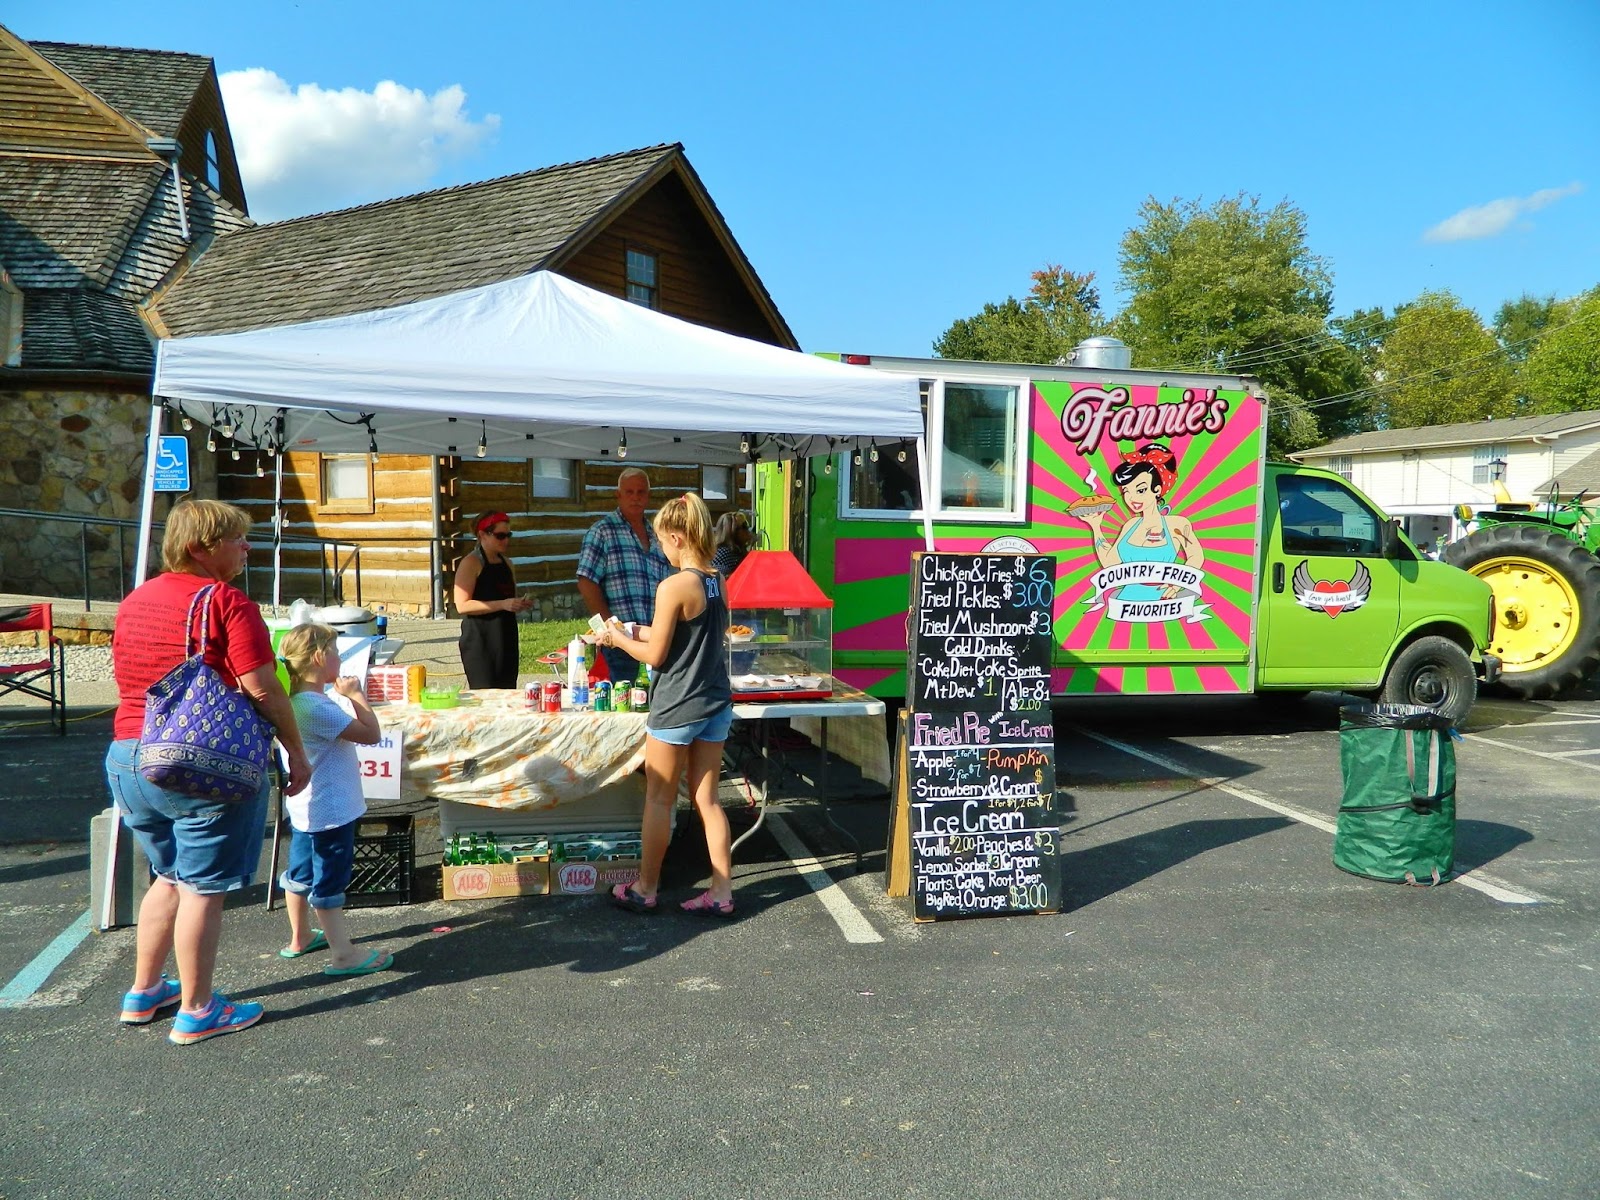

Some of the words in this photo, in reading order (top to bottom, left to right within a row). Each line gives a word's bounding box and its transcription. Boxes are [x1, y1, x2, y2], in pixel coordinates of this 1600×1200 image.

[1061, 387, 1229, 456] Fannie's
[705, 577, 720, 598] 21
[921, 582, 952, 608] Fried
[919, 609, 951, 634] Fried
[1120, 602, 1182, 619] FAVORITES
[944, 637, 972, 655] Cold
[950, 656, 974, 678] Diet
[1007, 656, 1042, 682] Sprite
[913, 712, 962, 746] Fried
[963, 711, 991, 745] Pie
[998, 720, 1020, 738] Ice
[1020, 719, 1054, 739] Cream
[911, 802, 960, 836] Ice
[962, 800, 1025, 833] Cream
[988, 870, 1014, 887] Root
[1015, 869, 1042, 886] Beer
[925, 893, 944, 911] Big
